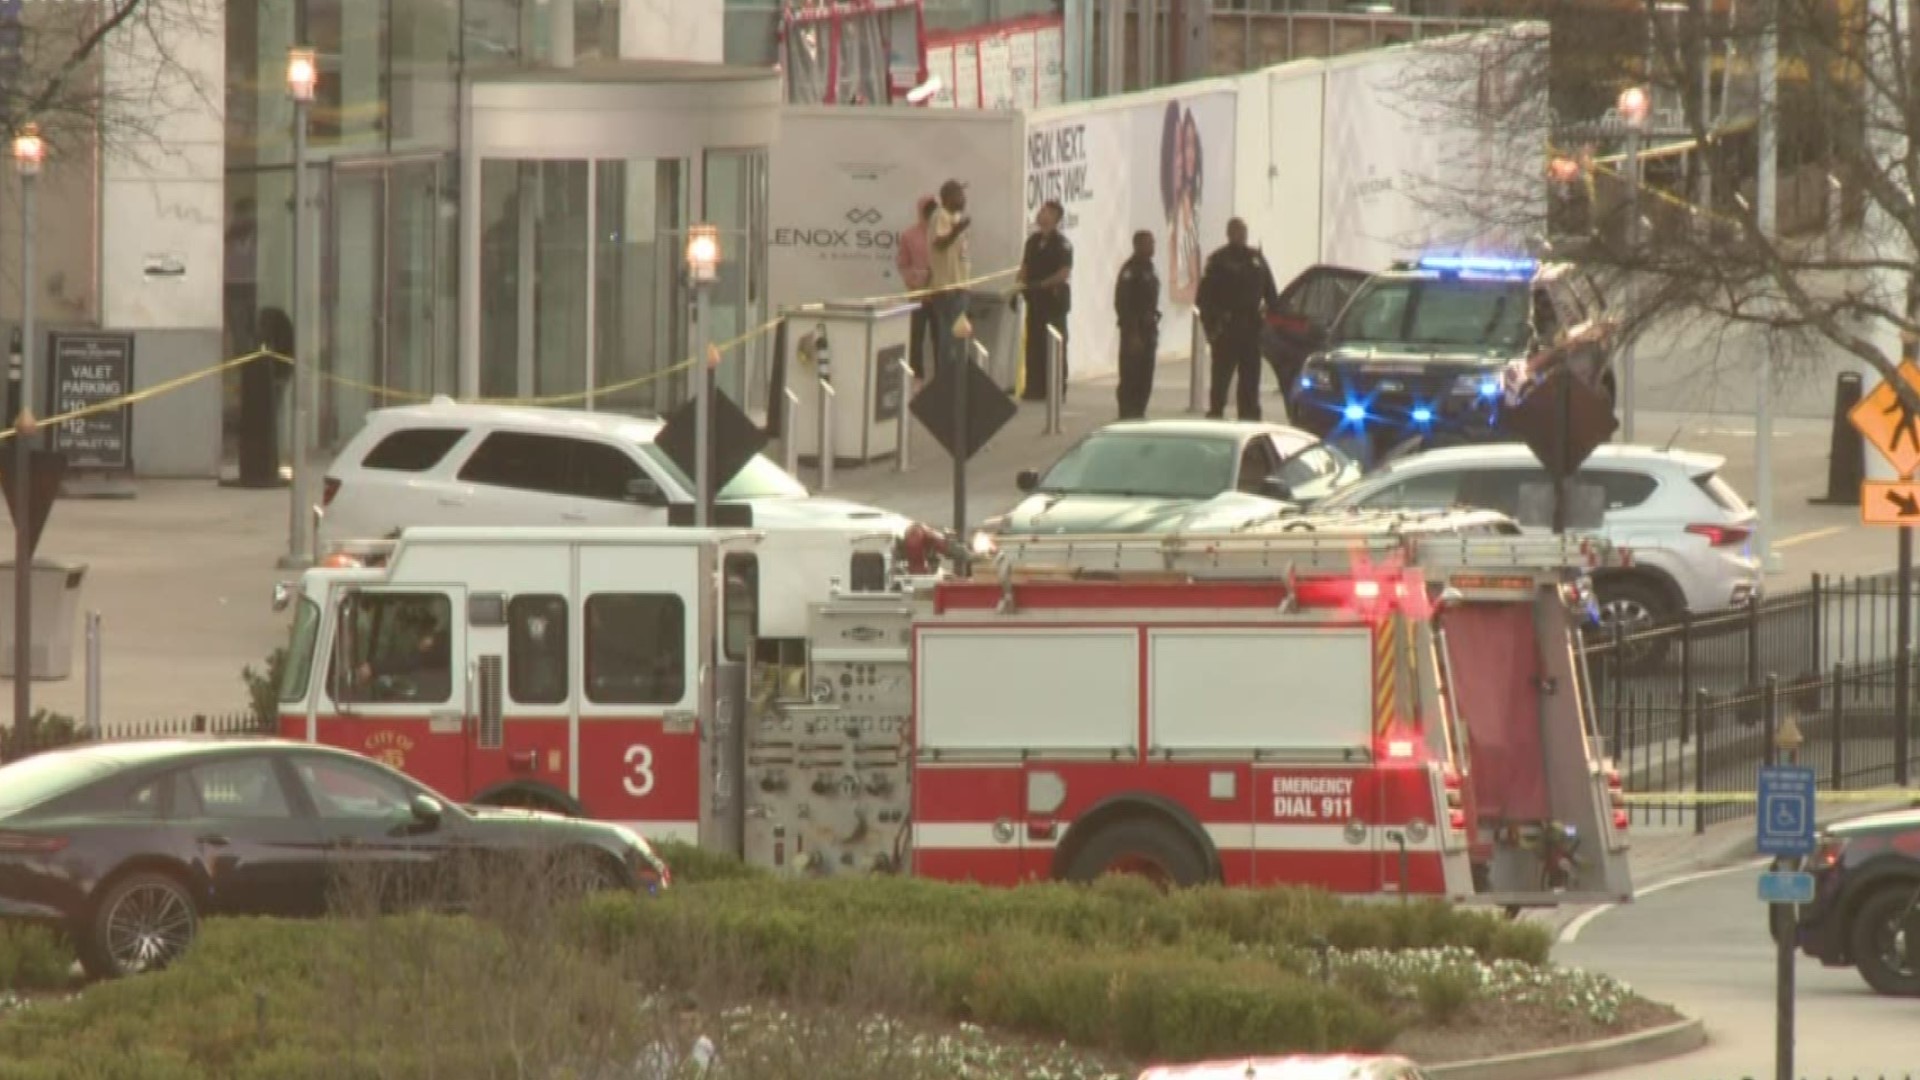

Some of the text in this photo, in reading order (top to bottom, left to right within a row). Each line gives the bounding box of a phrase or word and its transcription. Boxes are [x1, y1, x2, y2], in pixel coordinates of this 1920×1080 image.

[1056, 124, 1086, 162] NEXT.
[71, 365, 113, 379] VALET
[62, 380, 120, 394] PARKING
[622, 744, 654, 797] 3
[1272, 777, 1353, 794] EMERGENCY
[1273, 797, 1353, 817] DIAL 911
